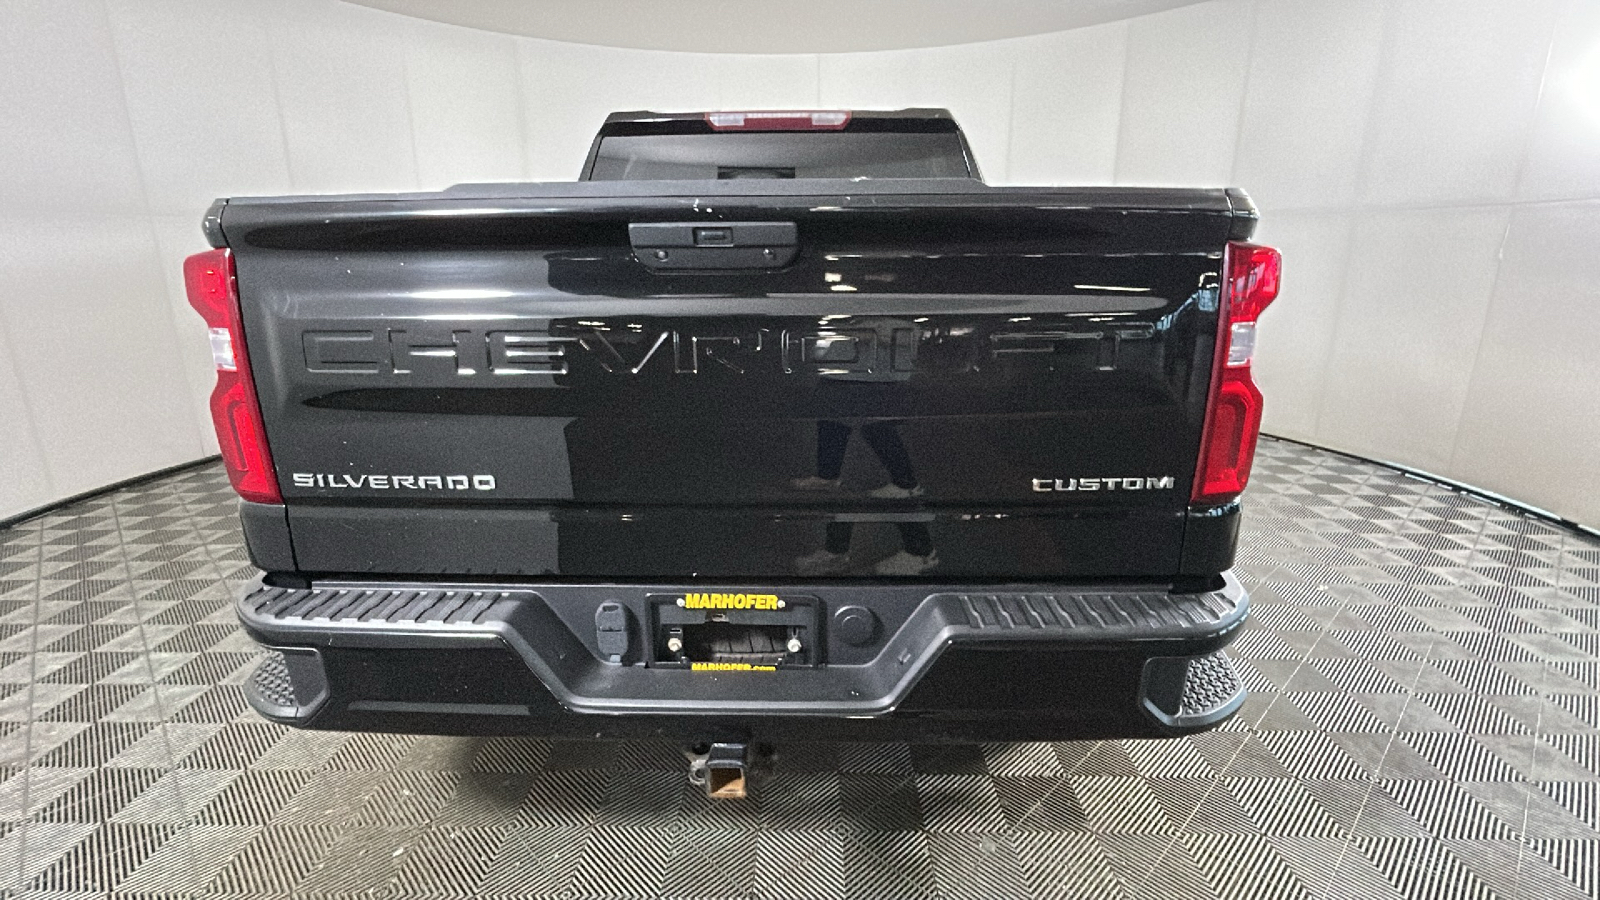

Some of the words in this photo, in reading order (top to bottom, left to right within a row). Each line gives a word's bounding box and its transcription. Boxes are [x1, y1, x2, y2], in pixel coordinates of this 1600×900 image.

[292, 473, 496, 490] SILVERADO
[1032, 476, 1175, 491] CUSTOM
[685, 593, 779, 609] MARHOFER
